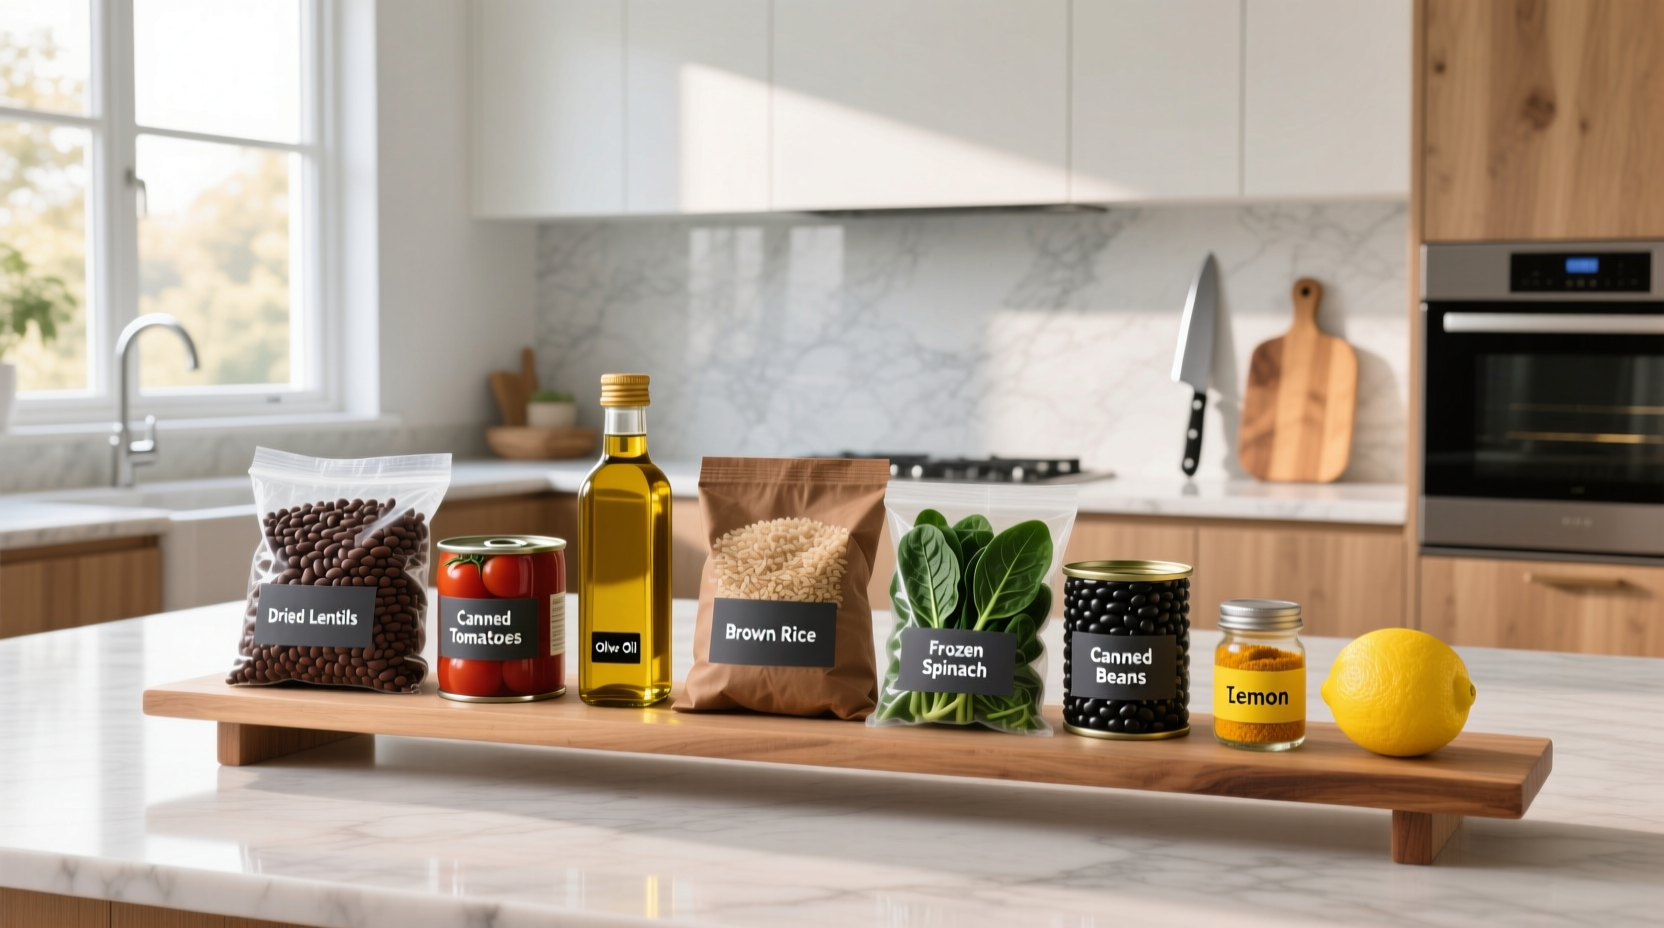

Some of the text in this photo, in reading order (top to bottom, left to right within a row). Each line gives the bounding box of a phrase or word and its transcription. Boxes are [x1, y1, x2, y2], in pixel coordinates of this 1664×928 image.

[267, 606, 358, 626] Dried Lentils
[456, 609, 511, 626] Canned
[449, 627, 522, 645] Tomatoes
[725, 623, 817, 643] Brown Rice
[929, 640, 984, 658] Frozen
[1090, 647, 1153, 665] Canned
[922, 659, 987, 679] Spinach
[1096, 667, 1147, 685] Beans
[1226, 685, 1289, 706] Lemon
